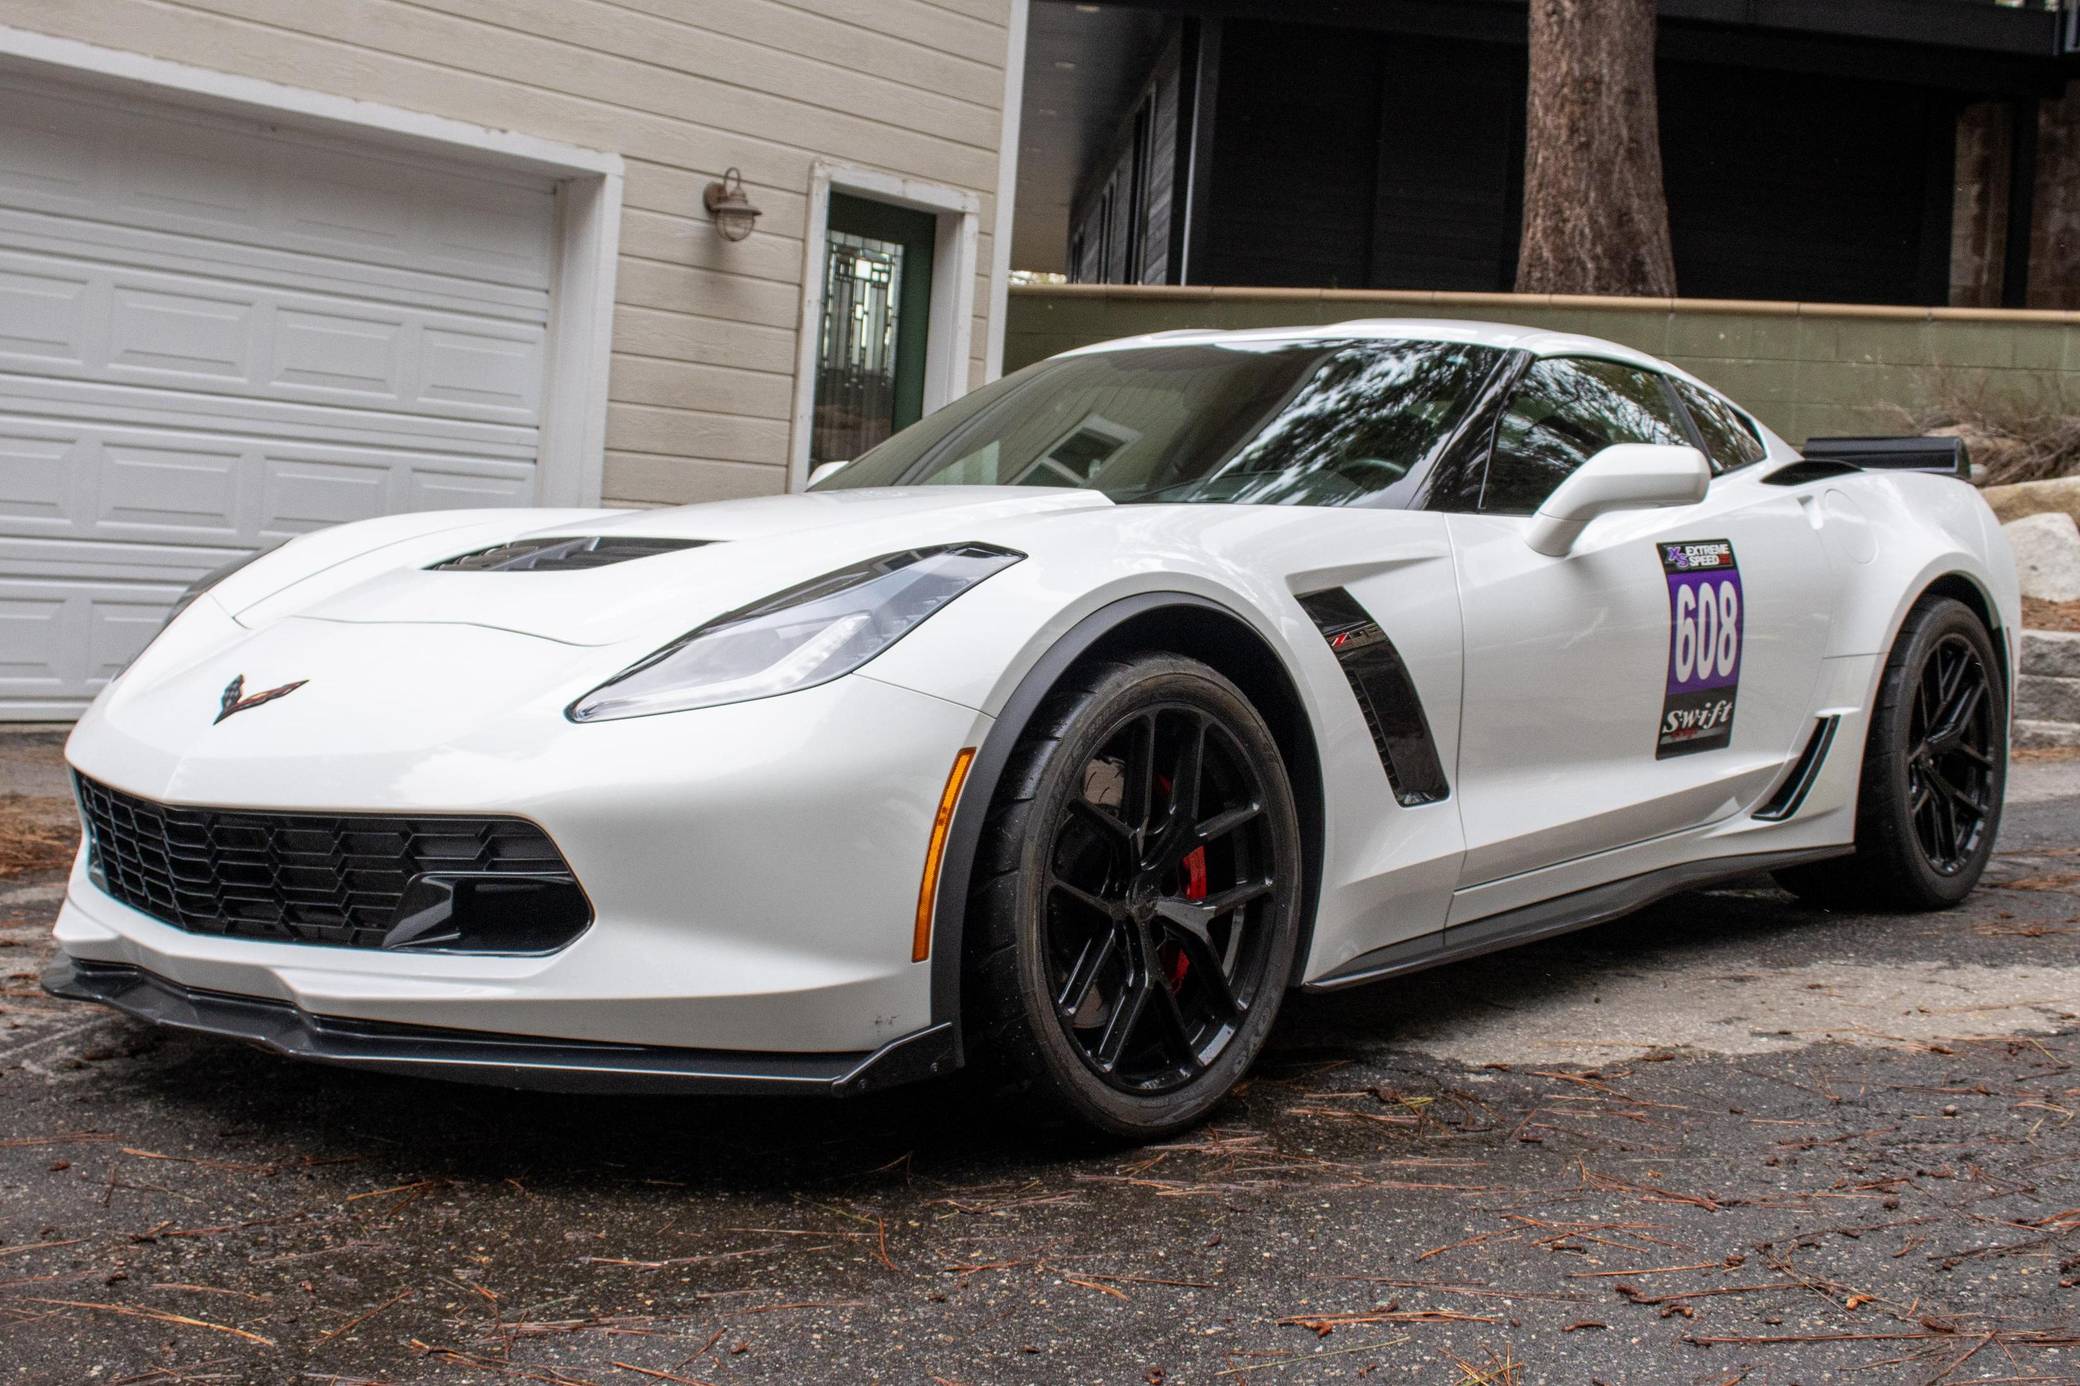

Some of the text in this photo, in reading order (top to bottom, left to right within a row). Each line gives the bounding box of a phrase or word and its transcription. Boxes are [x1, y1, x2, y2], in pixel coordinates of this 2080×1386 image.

[1685, 543, 1730, 557] EXTREME
[1688, 555, 1720, 567] SPEED
[1675, 580, 1738, 683] 608
[1662, 699, 1733, 734] Swift
